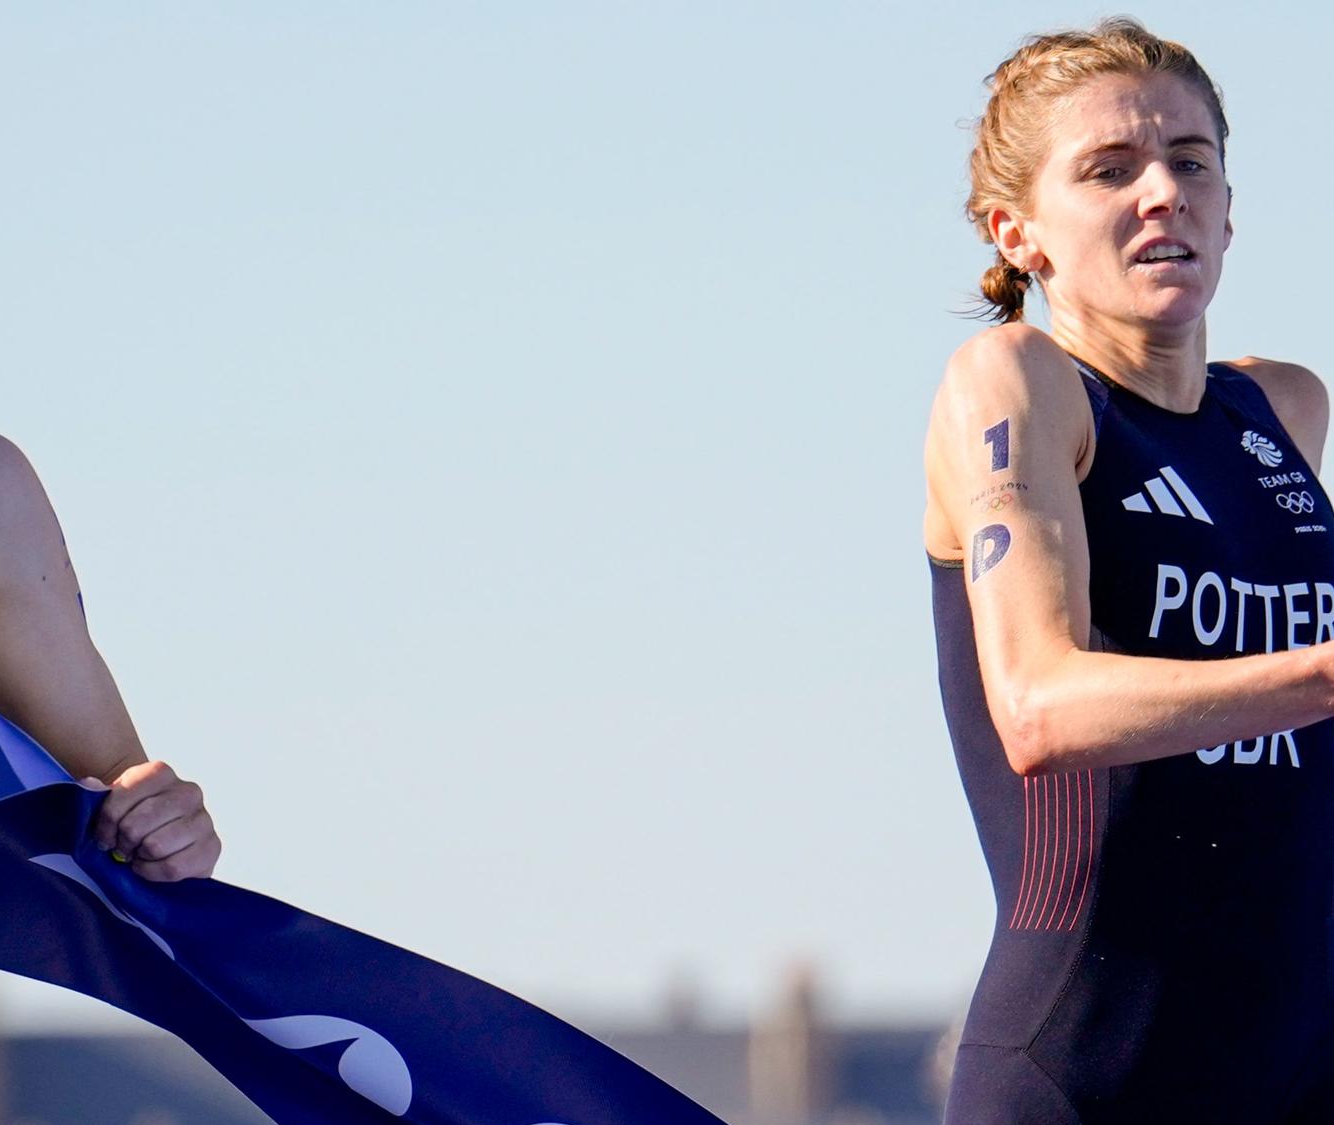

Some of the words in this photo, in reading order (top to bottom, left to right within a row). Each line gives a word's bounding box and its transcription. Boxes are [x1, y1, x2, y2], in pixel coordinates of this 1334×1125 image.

[984, 417, 1010, 473] 1
[1257, 473, 1292, 489] TEAM
[1289, 471, 1307, 483] GB
[971, 523, 1012, 583] D
